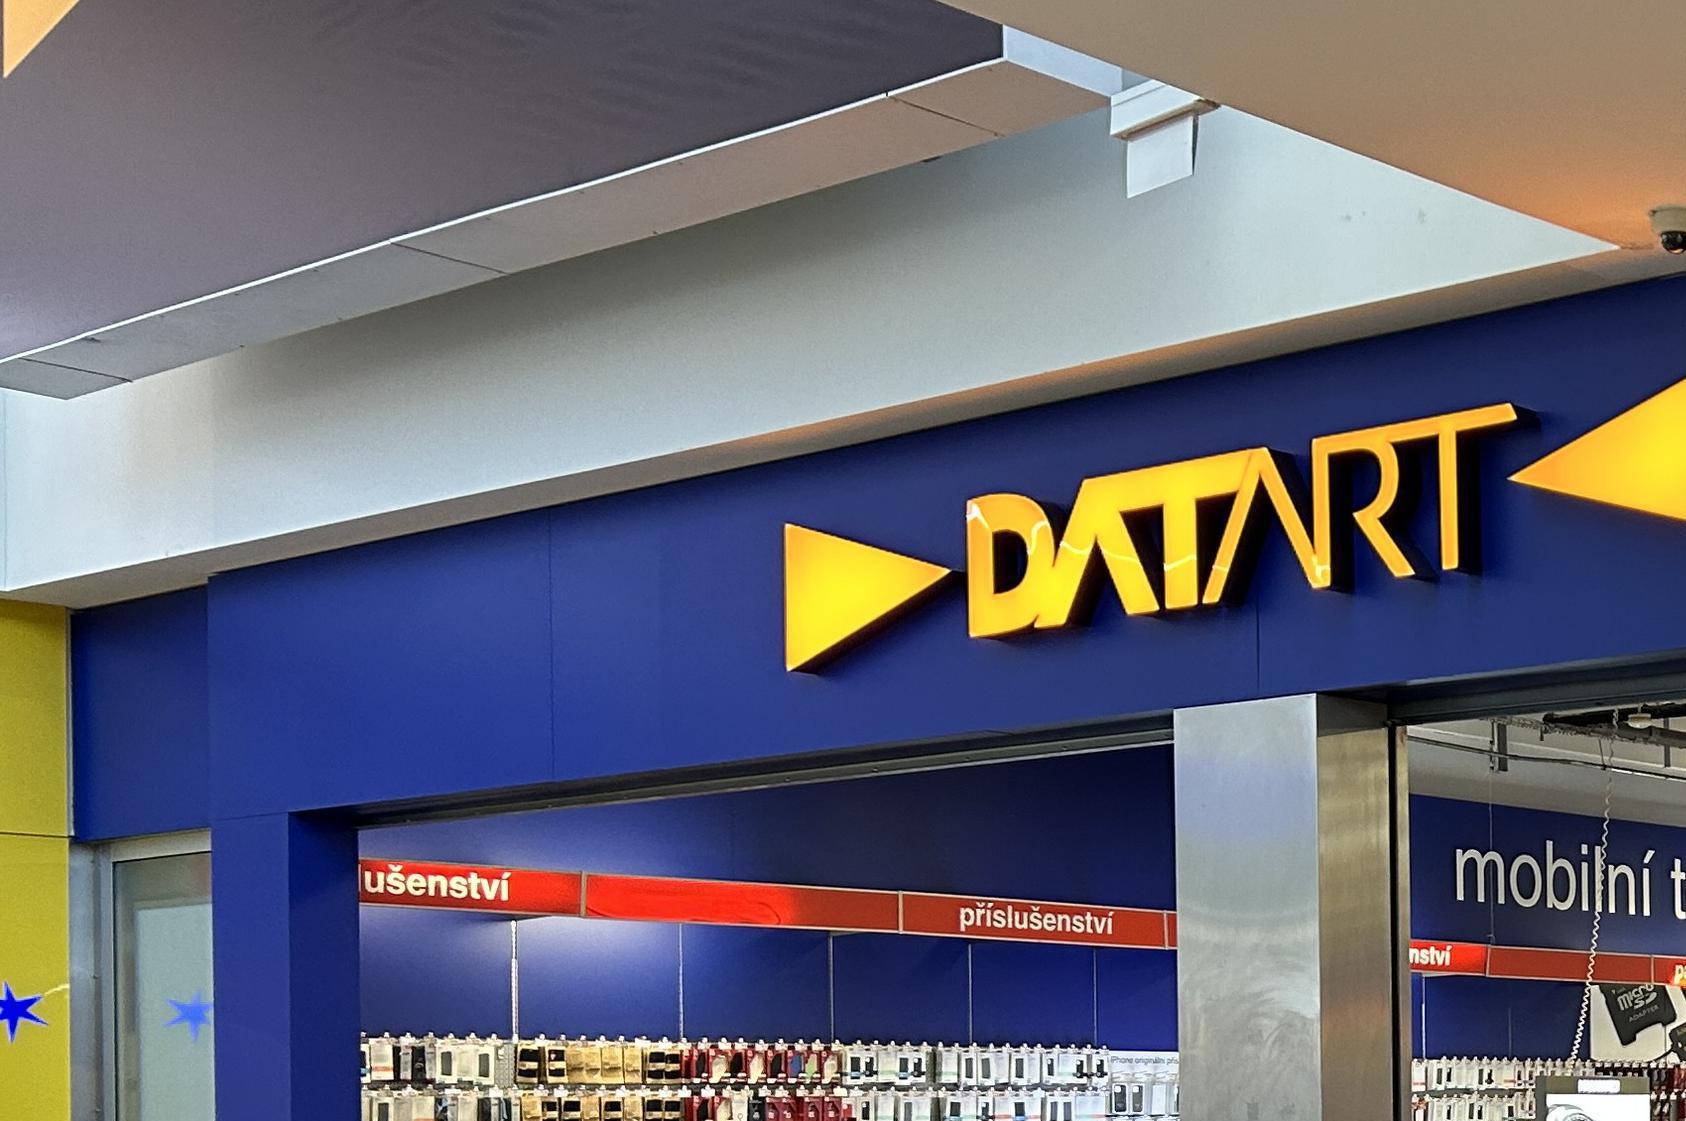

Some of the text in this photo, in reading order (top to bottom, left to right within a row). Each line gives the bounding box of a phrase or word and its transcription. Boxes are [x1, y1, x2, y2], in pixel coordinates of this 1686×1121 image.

[966, 402, 1520, 640] DATART
[959, 901, 1115, 935] příslušenství
[1455, 839, 1656, 918] mobilní
